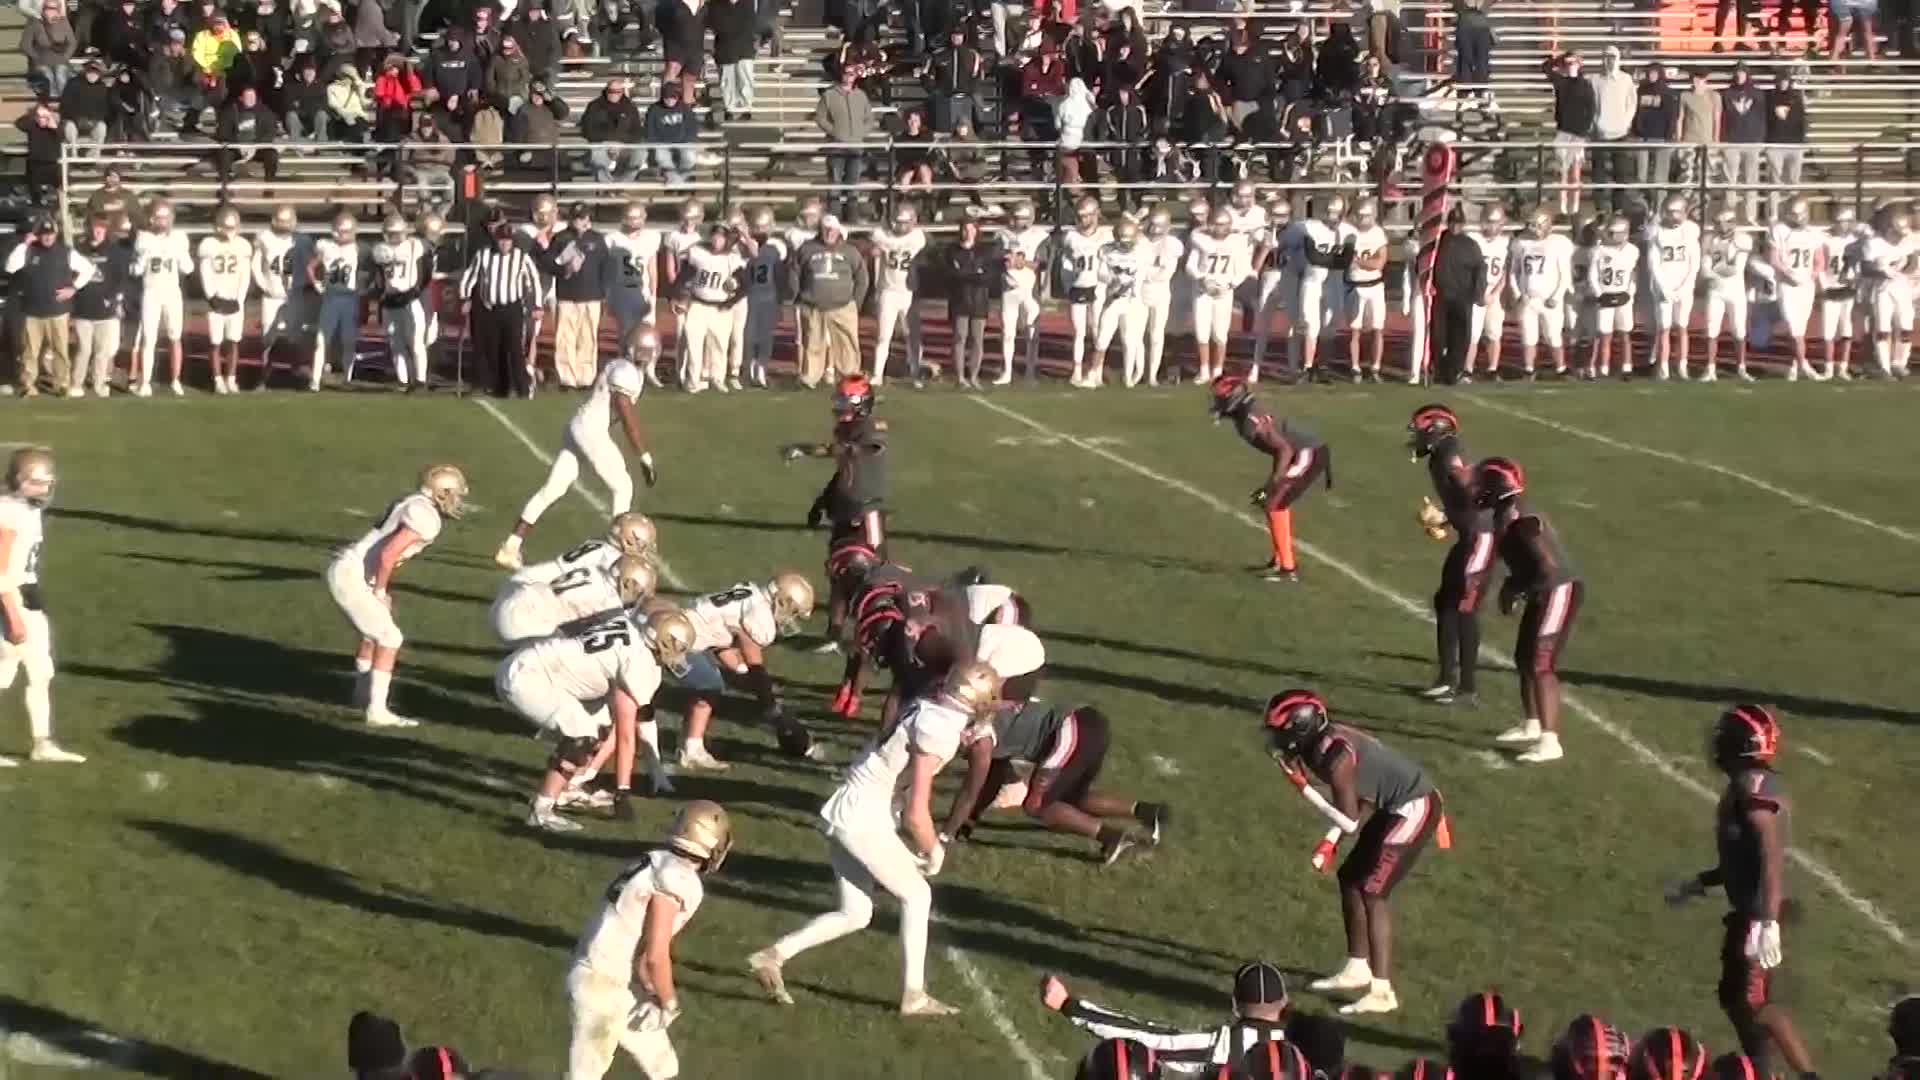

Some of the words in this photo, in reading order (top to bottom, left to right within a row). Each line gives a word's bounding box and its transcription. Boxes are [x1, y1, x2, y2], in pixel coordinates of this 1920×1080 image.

[214, 255, 237, 274] 32
[889, 250, 911, 270] 52
[1207, 254, 1231, 274] 77
[1524, 255, 1546, 276] 67
[582, 620, 631, 654] 75
